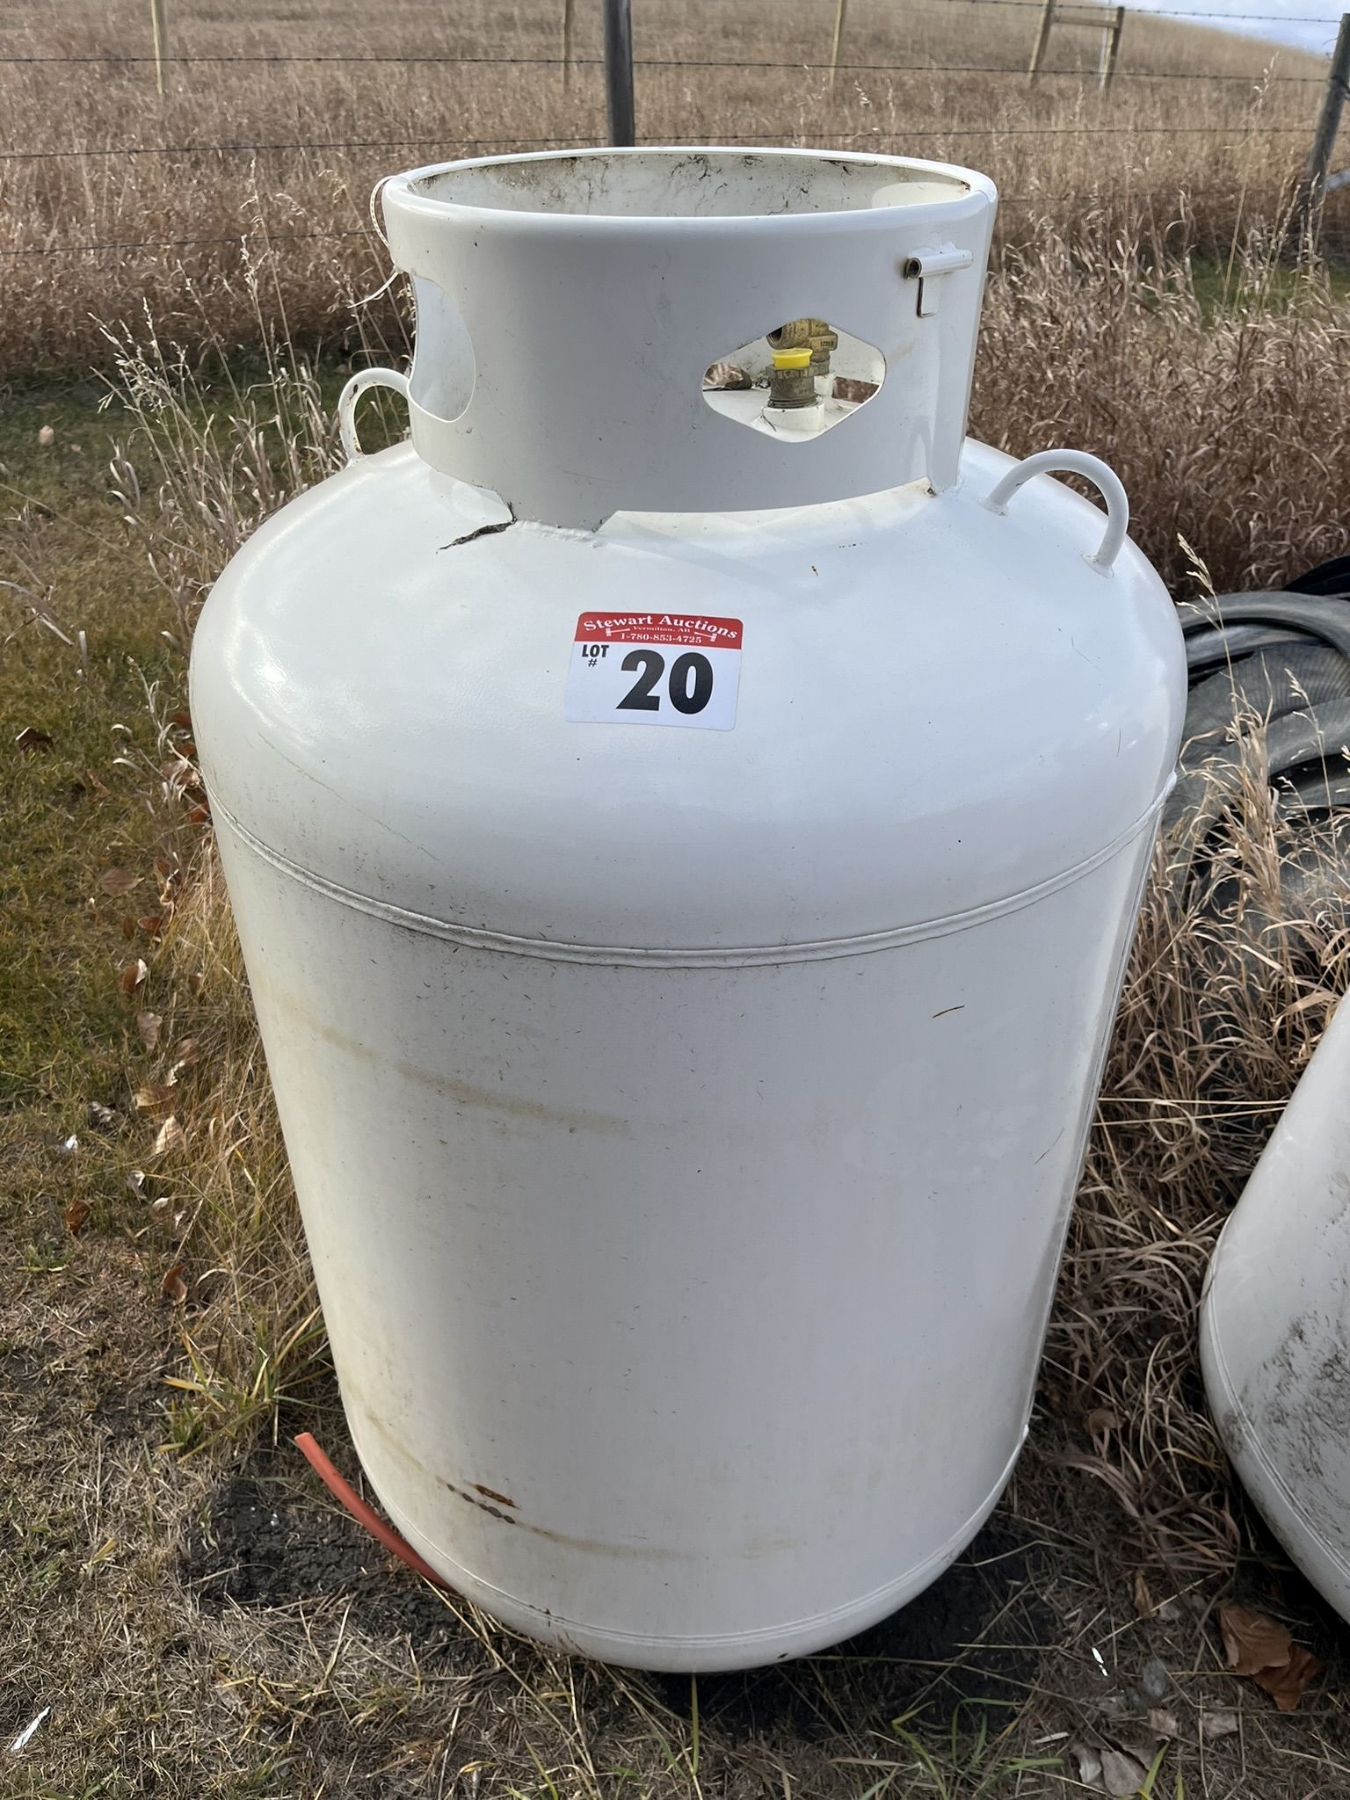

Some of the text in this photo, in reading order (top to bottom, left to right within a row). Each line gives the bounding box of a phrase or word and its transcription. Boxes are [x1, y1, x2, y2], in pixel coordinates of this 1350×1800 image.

[583, 615, 738, 639] Stewart Auctions
[620, 632, 702, 644] 1-780-853-4725
[582, 644, 609, 658] LOT
[588, 658, 598, 668] #
[615, 649, 714, 715] 20
